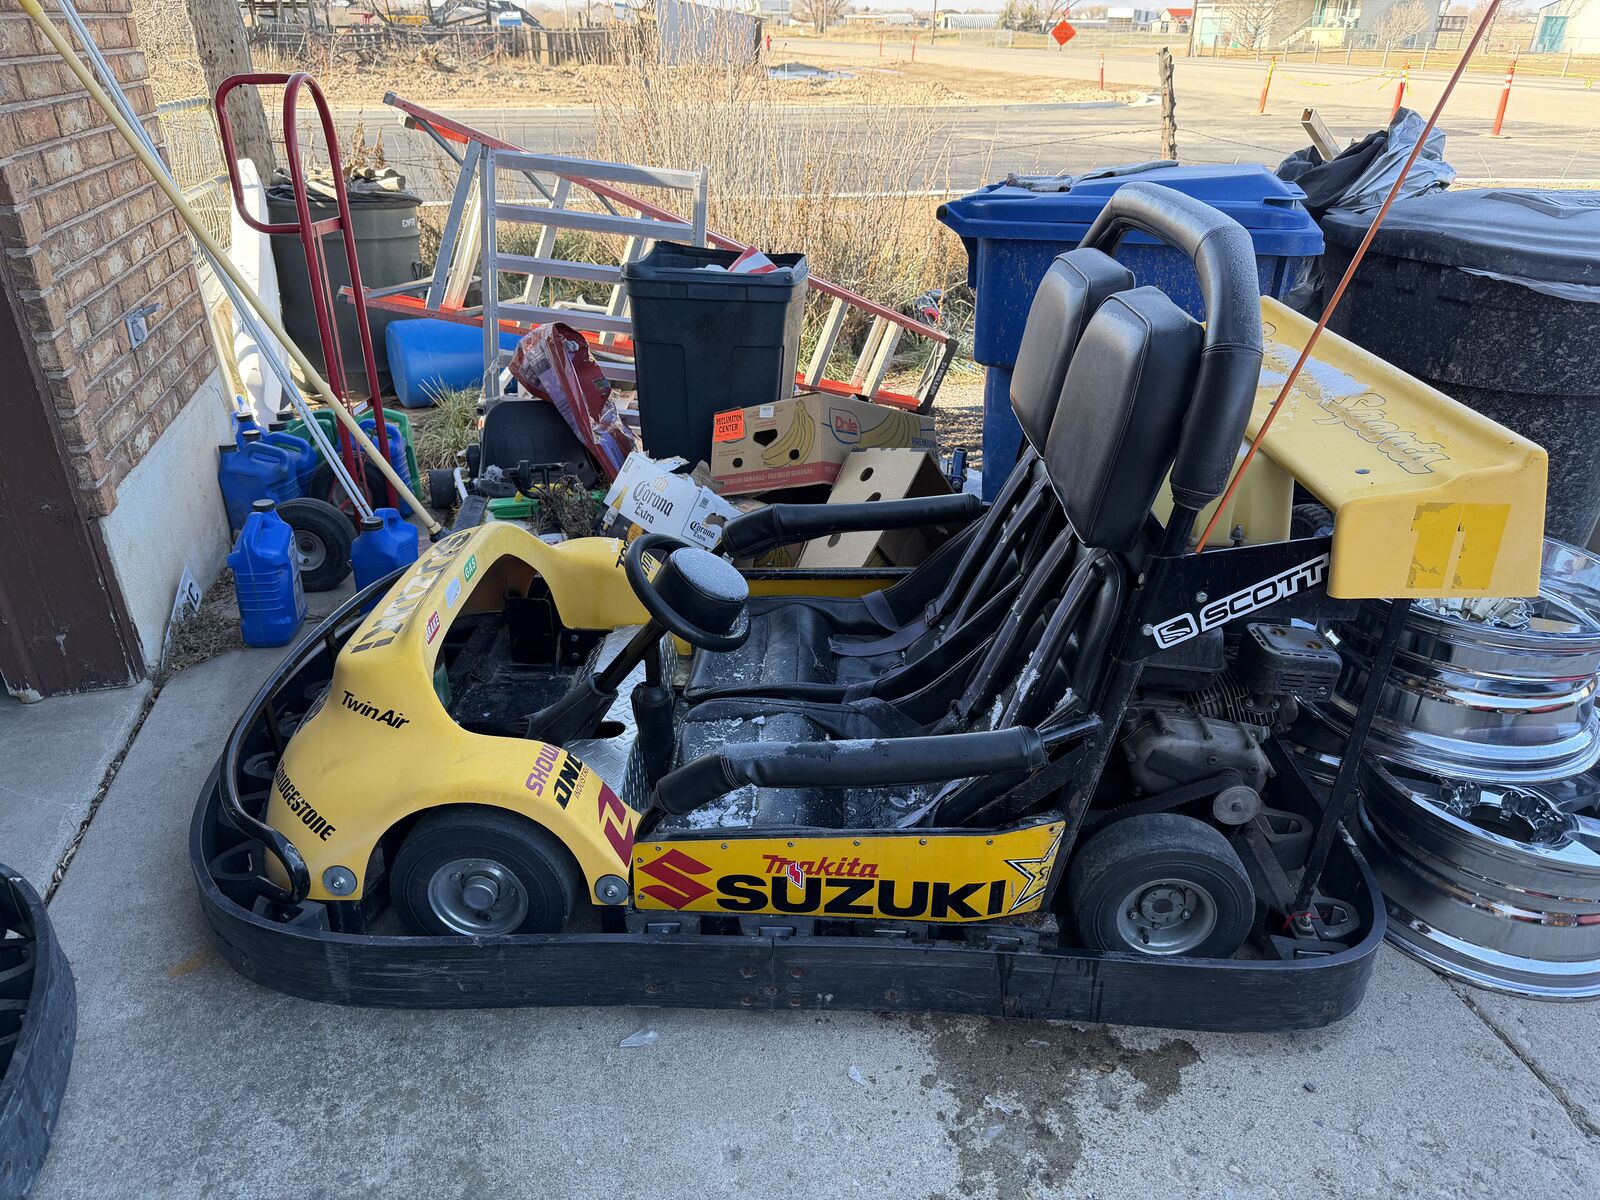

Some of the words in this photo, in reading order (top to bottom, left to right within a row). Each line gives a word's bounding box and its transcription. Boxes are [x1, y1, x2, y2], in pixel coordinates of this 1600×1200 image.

[718, 423, 739, 433] CENTER
[835, 415, 858, 432] Dole
[632, 480, 674, 517] Corona
[634, 502, 655, 524] Extra
[689, 520, 716, 539] Corona
[693, 531, 707, 542] Extra
[1405, 502, 1511, 590] 11
[464, 557, 477, 580] GAS
[1200, 552, 1330, 633] SCOTT
[525, 743, 561, 797] SHOW
[715, 874, 1007, 920] SUZUKI
